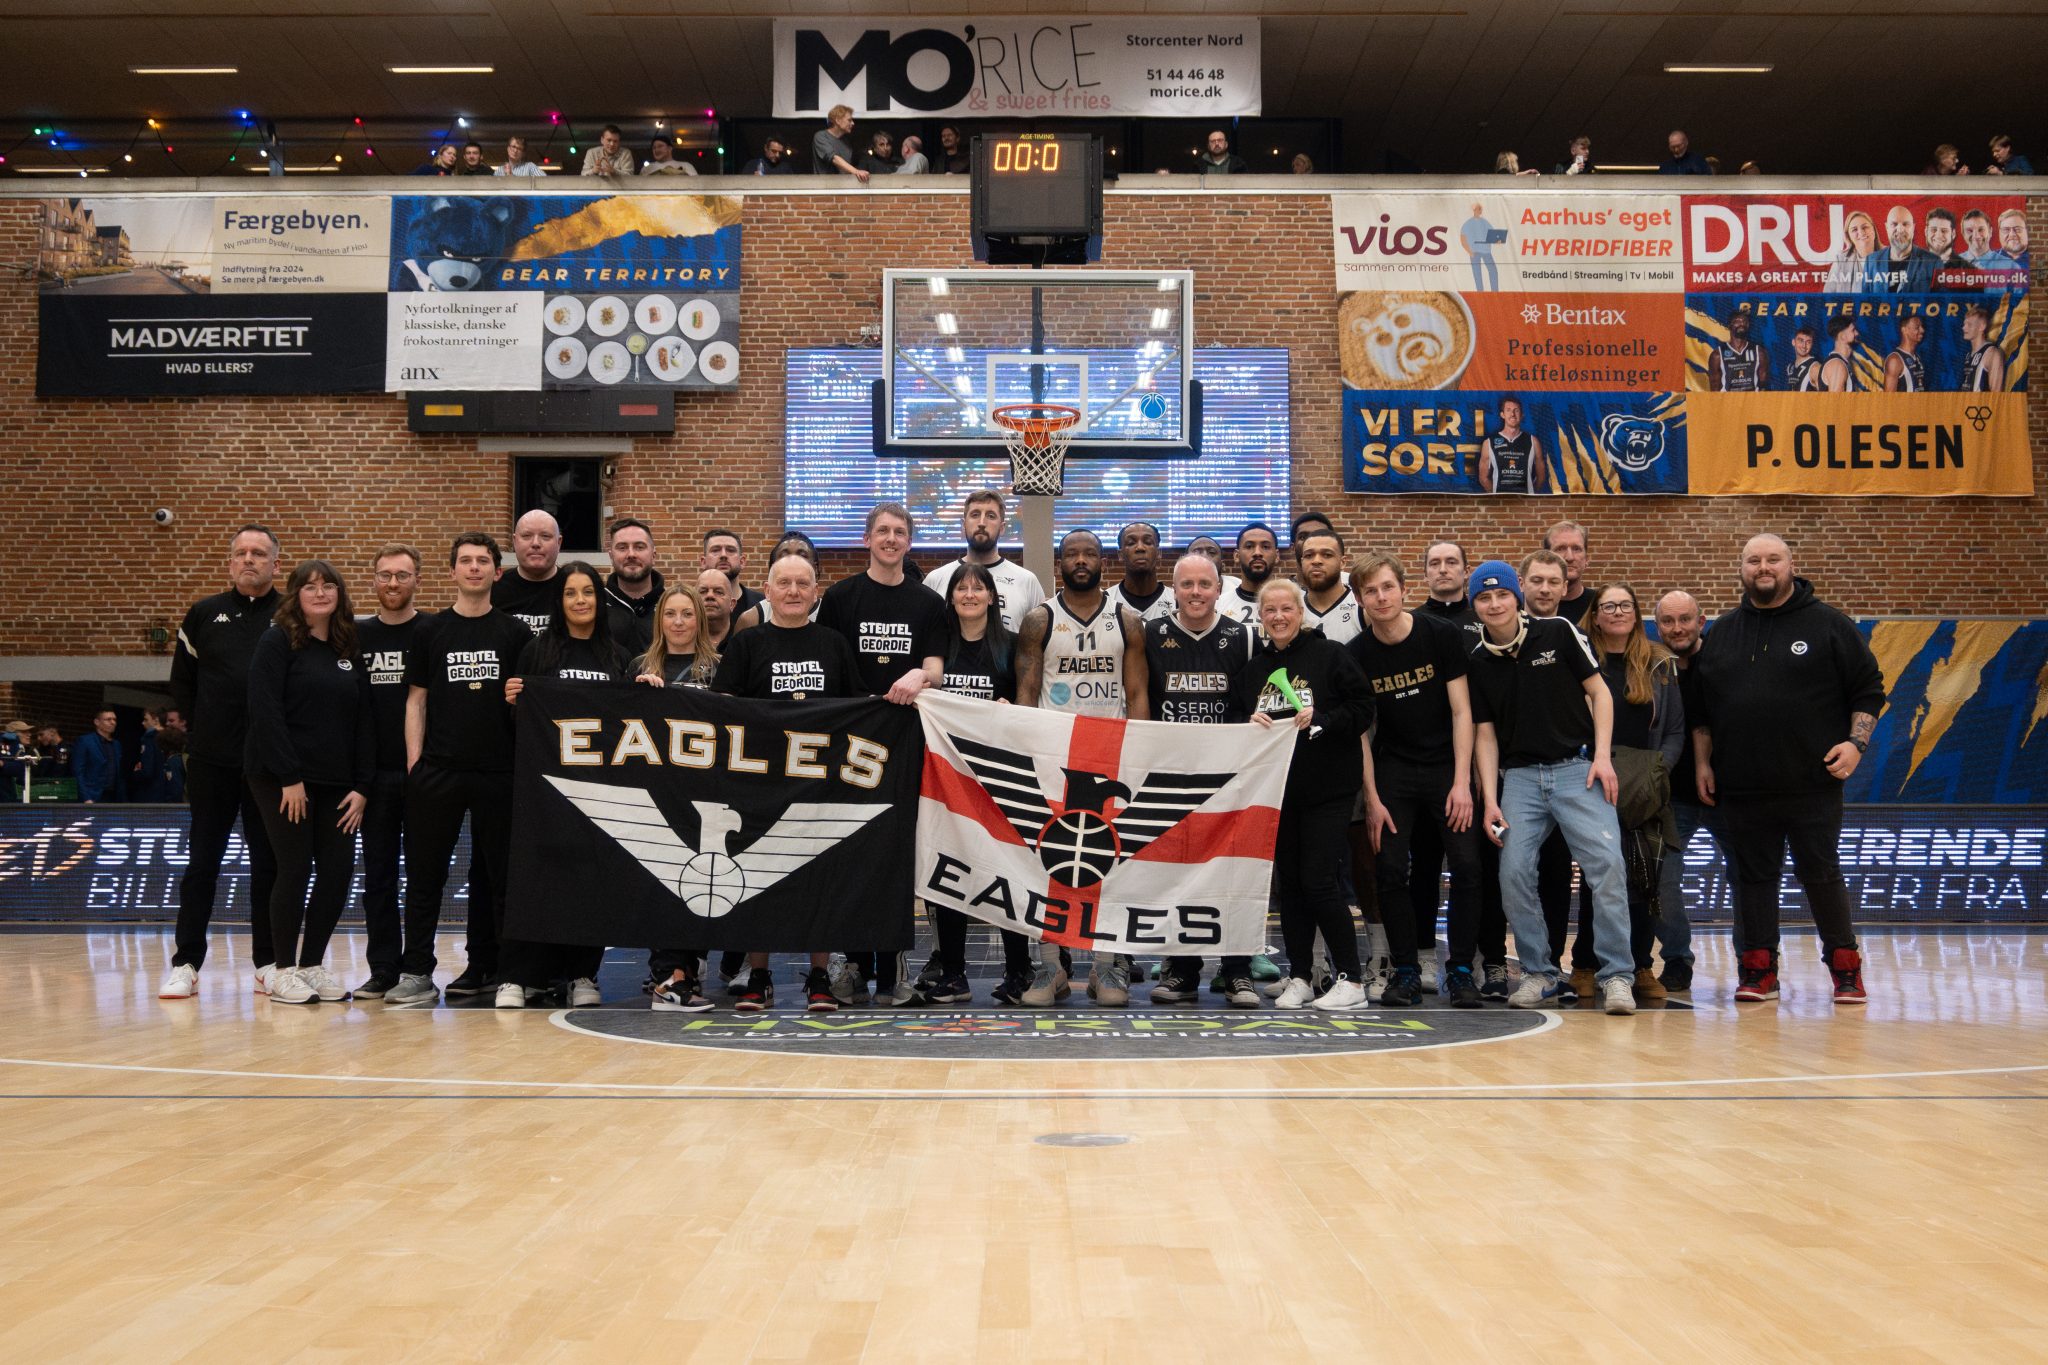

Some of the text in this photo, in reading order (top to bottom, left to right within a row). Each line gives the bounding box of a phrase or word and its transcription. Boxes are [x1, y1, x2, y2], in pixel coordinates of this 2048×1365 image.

[1126, 34, 1243, 46] Storcenter Nord
[1147, 69, 1225, 80] 51 44 46 48
[1150, 85, 1222, 98] morice.dk
[996, 91, 1057, 110] sweet
[1062, 90, 1112, 110] fries
[223, 209, 369, 235] Færgebyen.
[1619, 208, 1672, 232] eget
[1340, 213, 1449, 256] vios
[1690, 203, 1845, 267] DRU
[223, 241, 235, 250] Ny
[236, 237, 267, 247] maritim
[1521, 238, 1673, 257] HYBRIDFIBER
[222, 265, 304, 275] Indflytning fra 2024
[501, 267, 731, 282] BEAR TERRITORY
[1344, 263, 1450, 273] Sammen om mere
[1522, 269, 1674, 281] Bredbånd Streaming Tv Mobil
[222, 275, 232, 283] Se
[256, 275, 266, 285] på
[269, 275, 325, 285] færgebyen.dk
[1692, 271, 1909, 283] MAKES A GREAT TEAM PLAYER
[1937, 271, 2028, 286] designrus.dk
[405, 303, 519, 316] Nyfortolkninger af
[1546, 303, 1626, 326] Bentax
[404, 319, 507, 331] klassiske, danske
[111, 325, 309, 349] MADVÆRFTET
[403, 335, 519, 348] frokostanretninger
[1508, 338, 1658, 356] Professionelle
[165, 362, 254, 374] HVAD ELLERS?
[401, 366, 440, 380] anx
[1505, 363, 1661, 385] kaffeløsninger
[1361, 408, 1485, 436] VI ER I
[1747, 423, 1965, 469] P. OLESEN
[1362, 442, 1481, 476] SORT
[860, 622, 912, 636] STEUTEL
[861, 637, 910, 652] GEORDIE
[1075, 631, 1097, 652] 11
[446, 650, 499, 664] STEUTEL
[450, 666, 498, 679] GEORDIE
[771, 660, 824, 674] STEUTEL
[1056, 655, 1115, 675] EAGLES
[774, 676, 823, 690] GEORDIE
[942, 673, 994, 688] STEUTEL
[1165, 672, 1229, 693] EAGLES
[1371, 663, 1435, 694] EAGLES
[1075, 681, 1119, 699] ONE
[552, 718, 890, 790] EAGLES
[1935, 873, 2028, 909] FRA
[926, 852, 1223, 946] EAGLES
